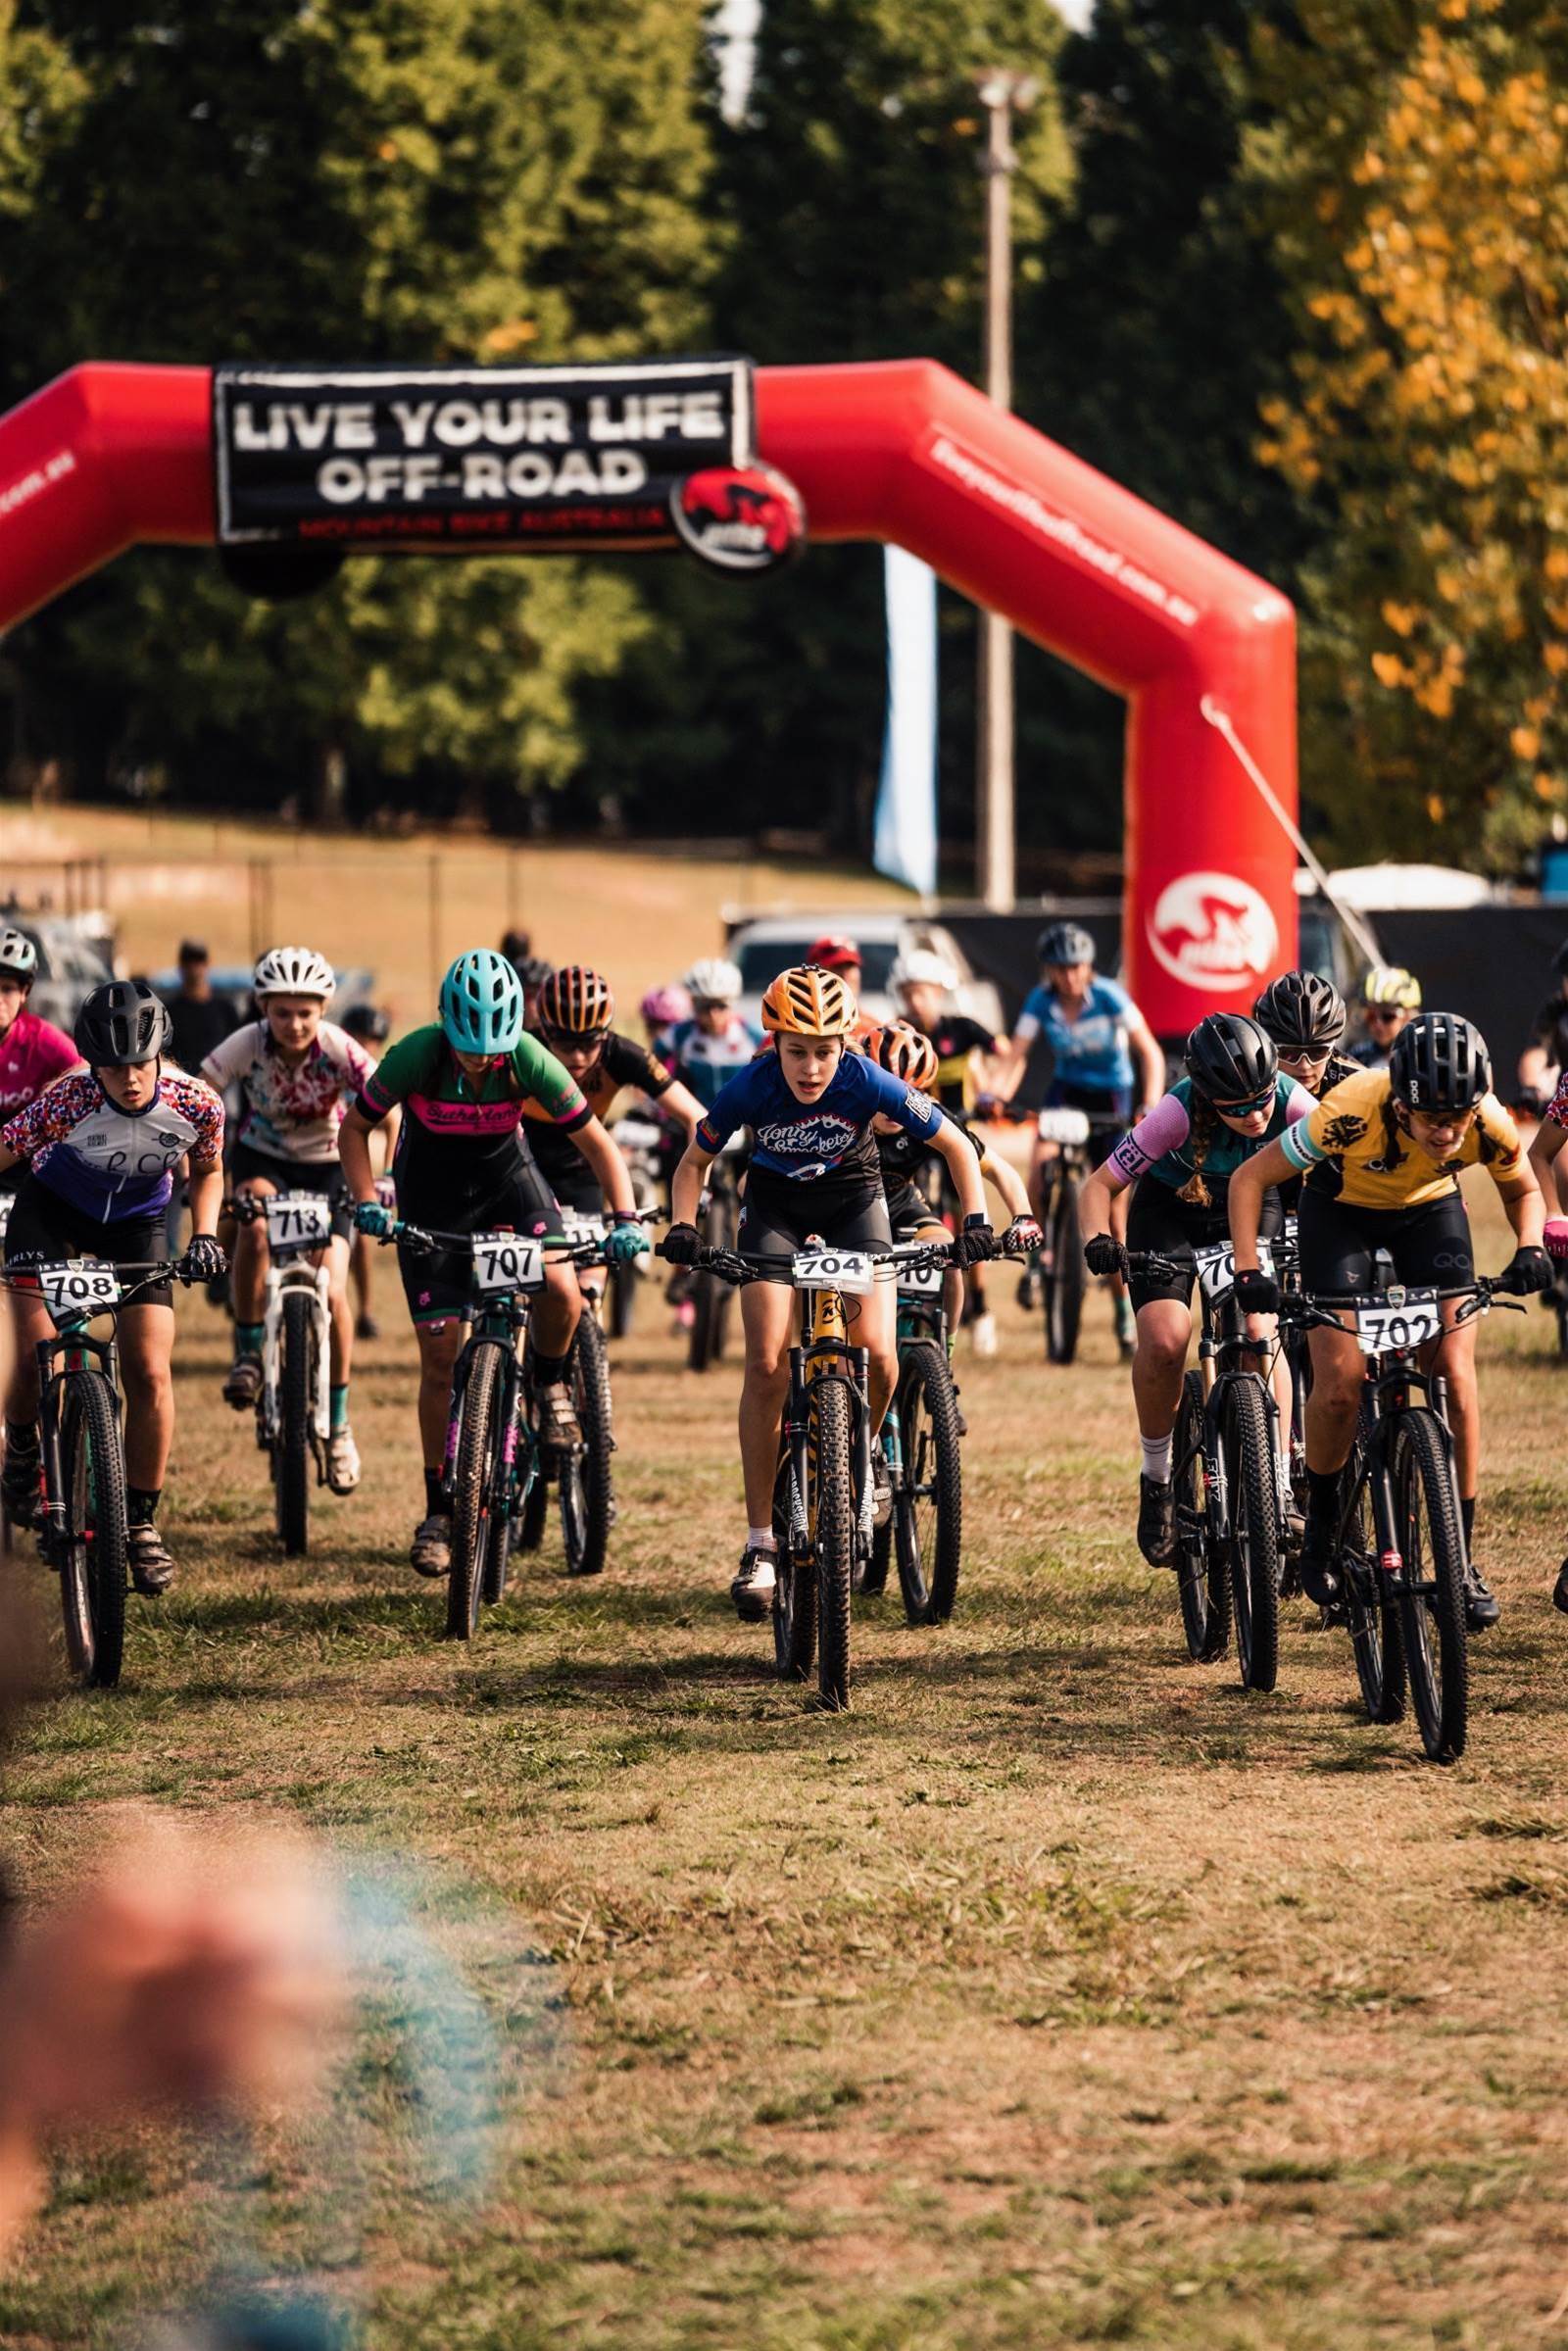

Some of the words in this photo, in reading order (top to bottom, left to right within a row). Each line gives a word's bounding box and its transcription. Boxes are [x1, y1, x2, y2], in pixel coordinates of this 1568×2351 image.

[233, 403, 377, 451] LIVE
[392, 398, 572, 448] YOUR
[588, 391, 726, 442] LIFE
[317, 450, 647, 504] OFF-ROAD
[275, 1208, 319, 1238] 713
[481, 1248, 533, 1282] 707
[799, 1256, 863, 1275] 704
[904, 1260, 933, 1285] 10
[1204, 1251, 1265, 1287] 70
[46, 1276, 113, 1308] 708
[1365, 1313, 1432, 1349] 702
